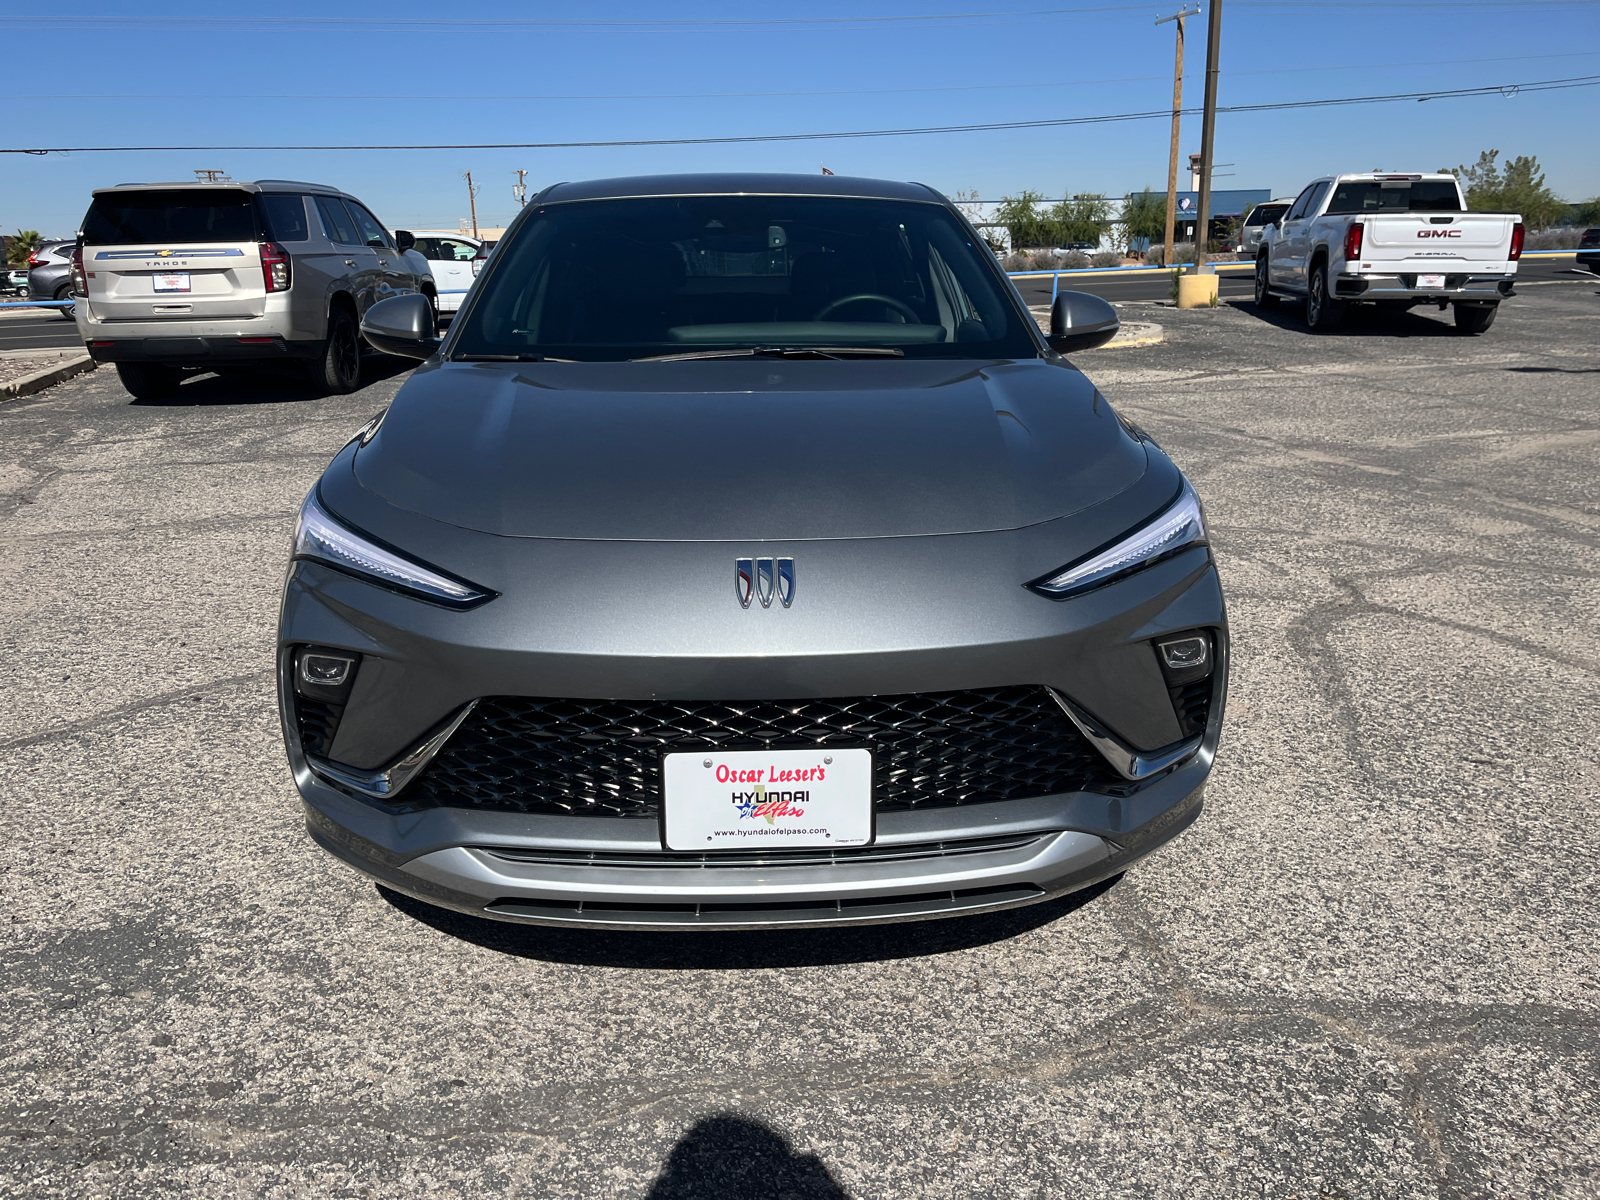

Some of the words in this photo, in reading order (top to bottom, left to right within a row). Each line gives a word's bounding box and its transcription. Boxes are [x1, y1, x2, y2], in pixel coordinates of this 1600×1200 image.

[1417, 229, 1462, 238] GMC
[716, 764, 765, 783] Oscar
[768, 764, 826, 783] Leeser's
[731, 790, 810, 804] HYUNDAI
[753, 801, 777, 818] El
[770, 800, 805, 819] Paso
[713, 827, 828, 837] www.hyundaiofelpaso.com
